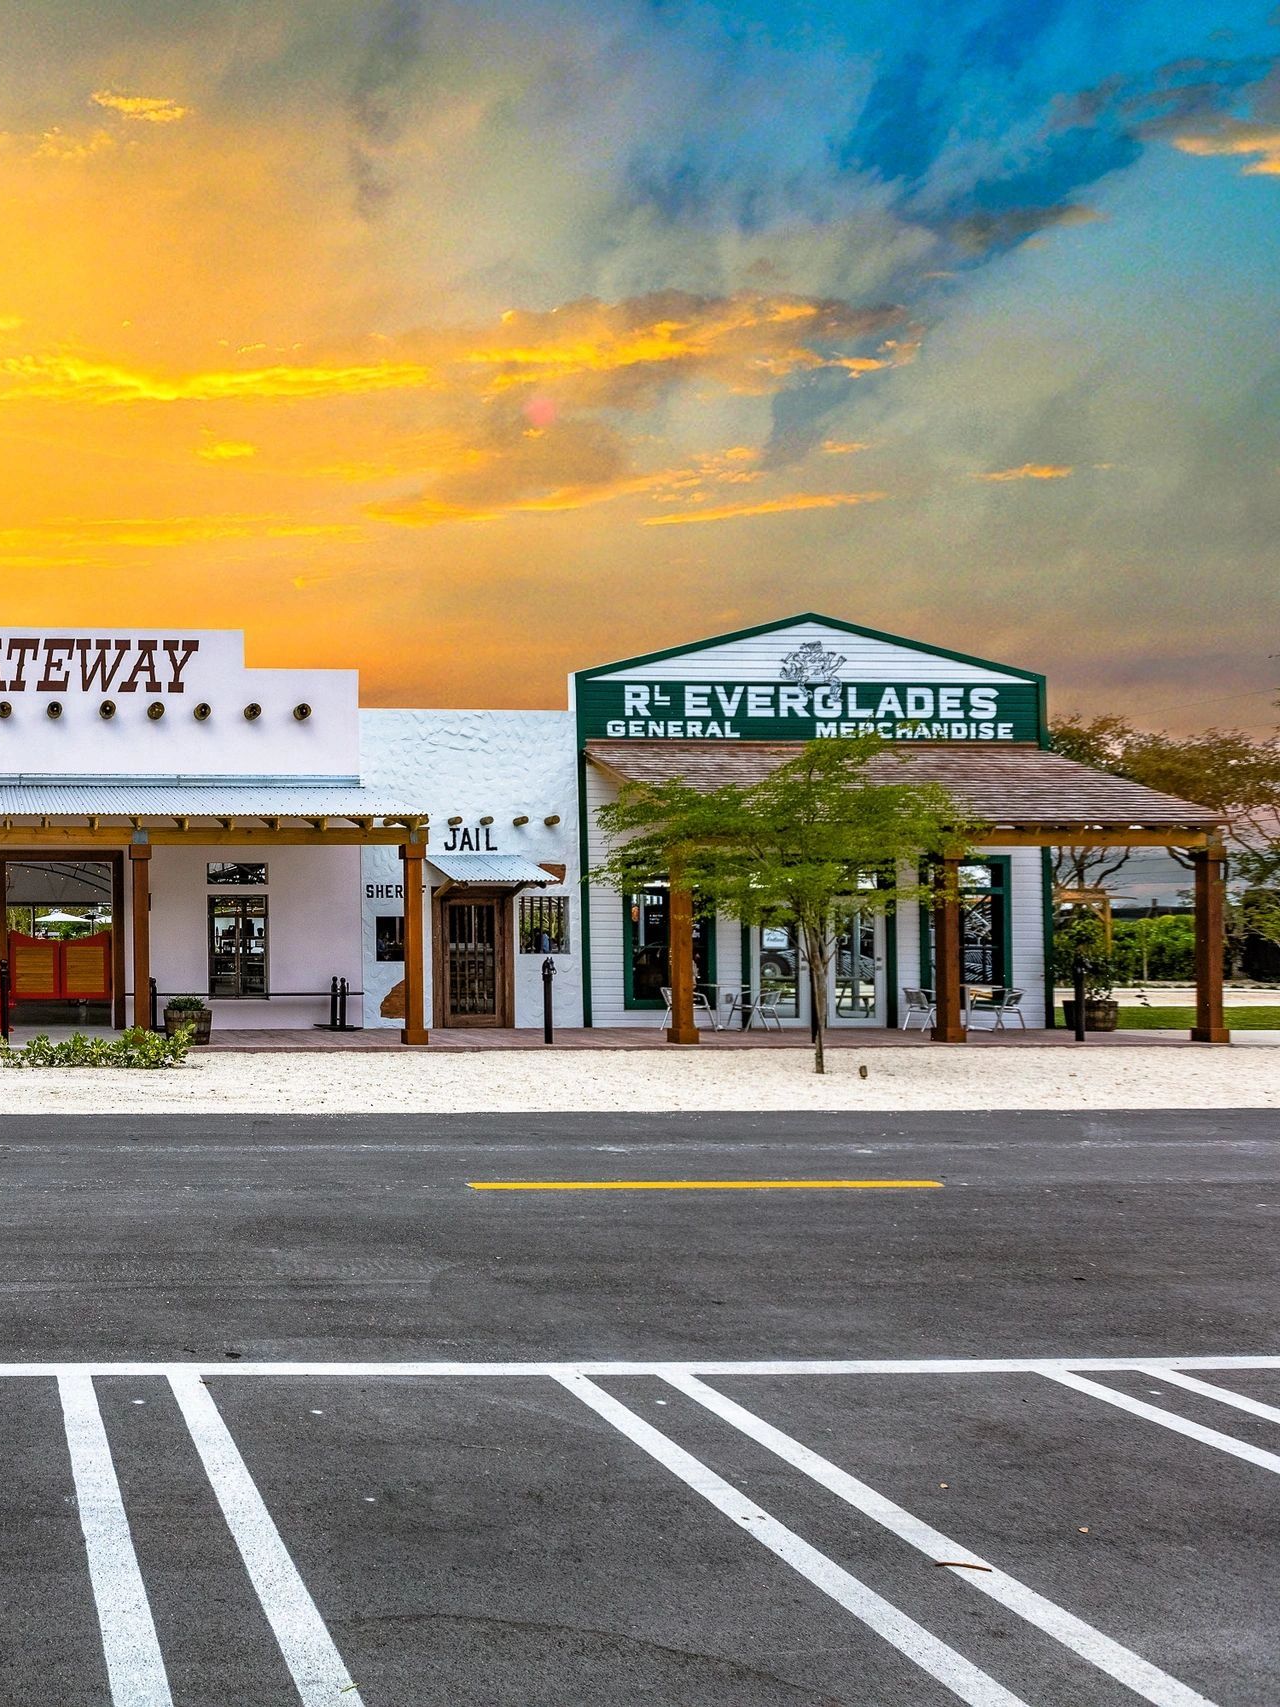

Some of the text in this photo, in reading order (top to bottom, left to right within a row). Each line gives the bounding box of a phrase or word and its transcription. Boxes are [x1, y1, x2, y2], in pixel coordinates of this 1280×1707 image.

[684, 684, 1000, 719] EVERGLADES
[606, 720, 741, 738] GENERAL
[444, 827, 498, 851] JAIL
[365, 884, 427, 899] SHER
